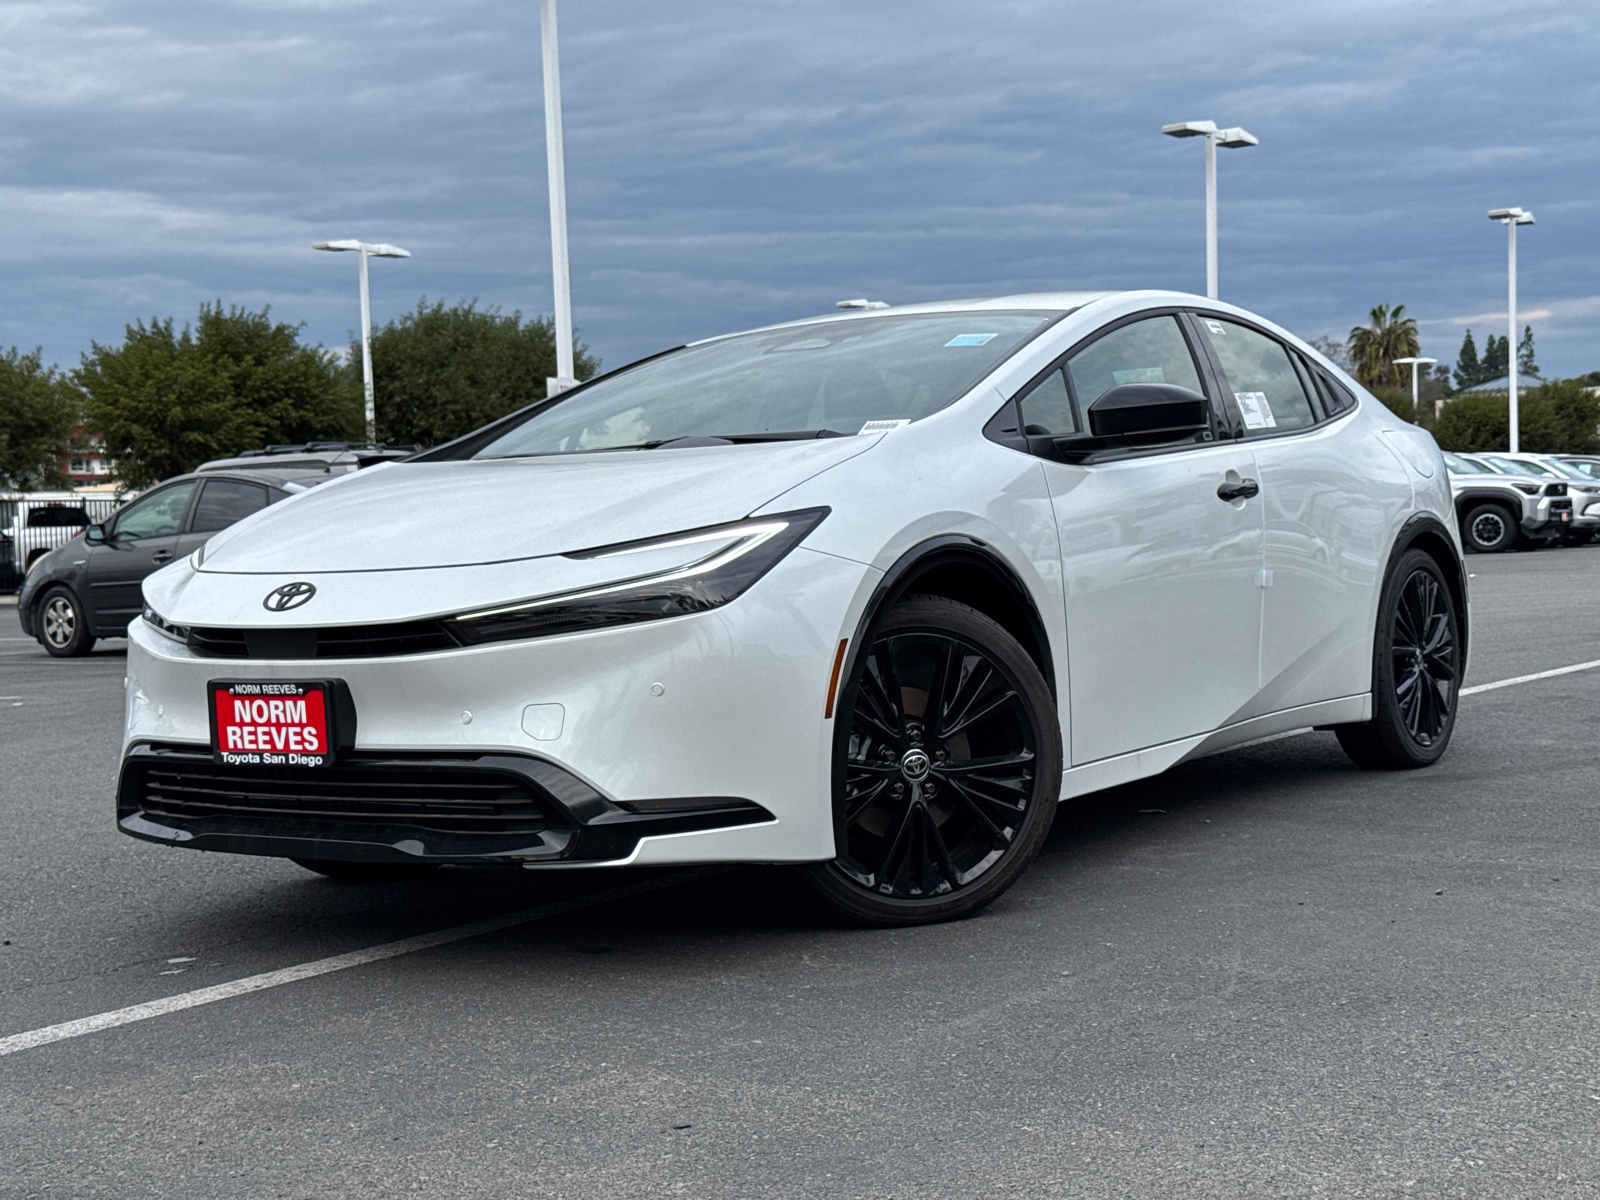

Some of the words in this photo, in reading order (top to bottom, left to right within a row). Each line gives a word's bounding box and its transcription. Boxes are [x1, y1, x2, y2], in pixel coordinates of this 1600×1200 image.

[235, 684, 261, 694] NORM
[263, 684, 297, 694] REEVES
[233, 699, 307, 723] NORM
[226, 726, 319, 750] REEVES
[221, 752, 260, 765] Toyota
[263, 753, 286, 764] San
[288, 754, 323, 767] Diego
